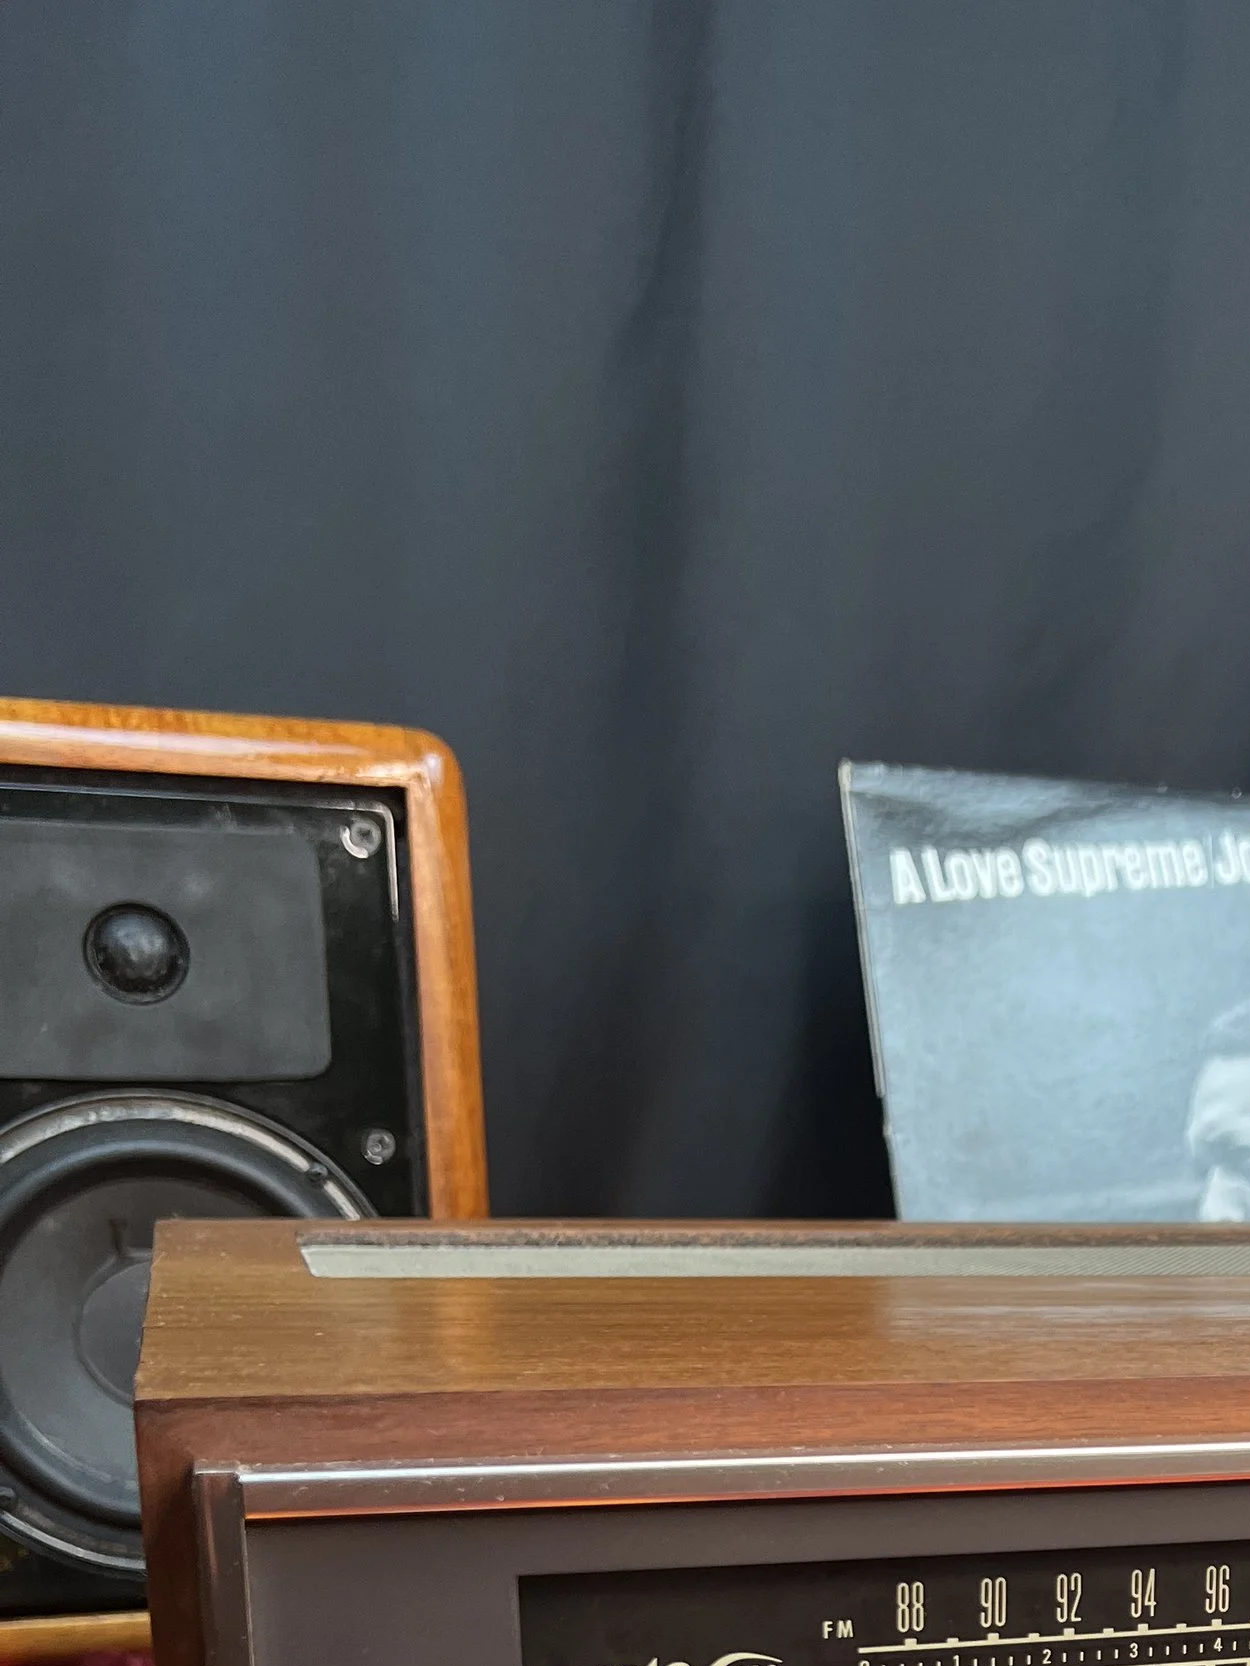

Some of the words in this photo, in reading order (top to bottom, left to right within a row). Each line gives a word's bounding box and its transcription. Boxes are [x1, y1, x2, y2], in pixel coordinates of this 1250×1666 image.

[889, 846, 926, 904] A
[921, 844, 1023, 902] Love
[1022, 838, 1208, 898] Supreme
[822, 1621, 854, 1639] FM
[897, 1581, 925, 1632] 88
[980, 1577, 1007, 1628] 90
[1056, 1573, 1082, 1623] 92
[1131, 1568, 1157, 1618] 94
[1205, 1565, 1231, 1614] 96
[1042, 1649, 1051, 1665] 2
[1130, 1643, 1138, 1658] 3
[1213, 1637, 1222, 1653] 4
